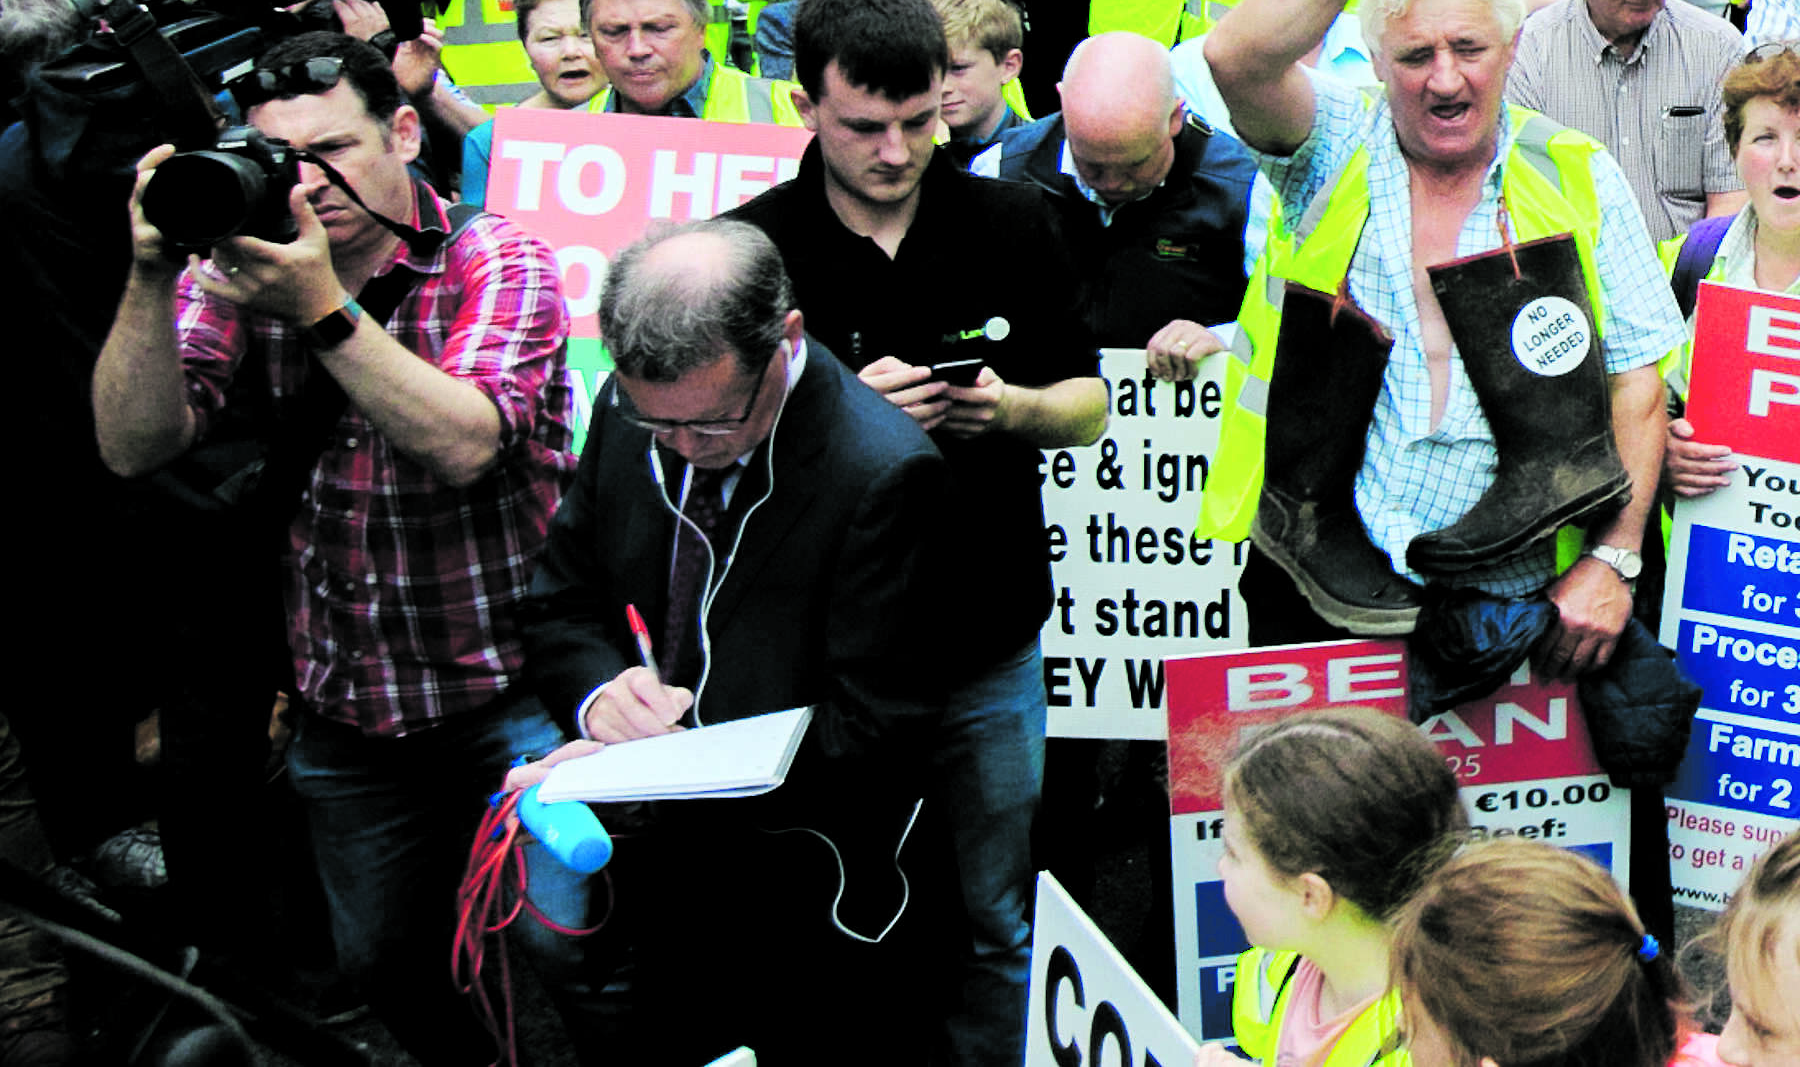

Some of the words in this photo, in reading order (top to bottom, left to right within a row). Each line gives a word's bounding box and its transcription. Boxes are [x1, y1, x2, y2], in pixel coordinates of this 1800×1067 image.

[502, 139, 627, 216] TO
[1523, 312, 1576, 353] LONGER
[1527, 305, 1548, 325] NO
[1536, 330, 1585, 369] NEEDED
[1096, 438, 1124, 490] &
[1087, 512, 1213, 566] these
[1095, 587, 1231, 639] stand
[1741, 584, 1788, 615] for
[1729, 678, 1774, 710] for
[1475, 782, 1611, 812] €10.00
[1717, 772, 1763, 803] for
[1768, 778, 1793, 810] 2
[1665, 805, 1736, 837] Please
[1691, 847, 1727, 869] get
[1732, 855, 1744, 871] a
